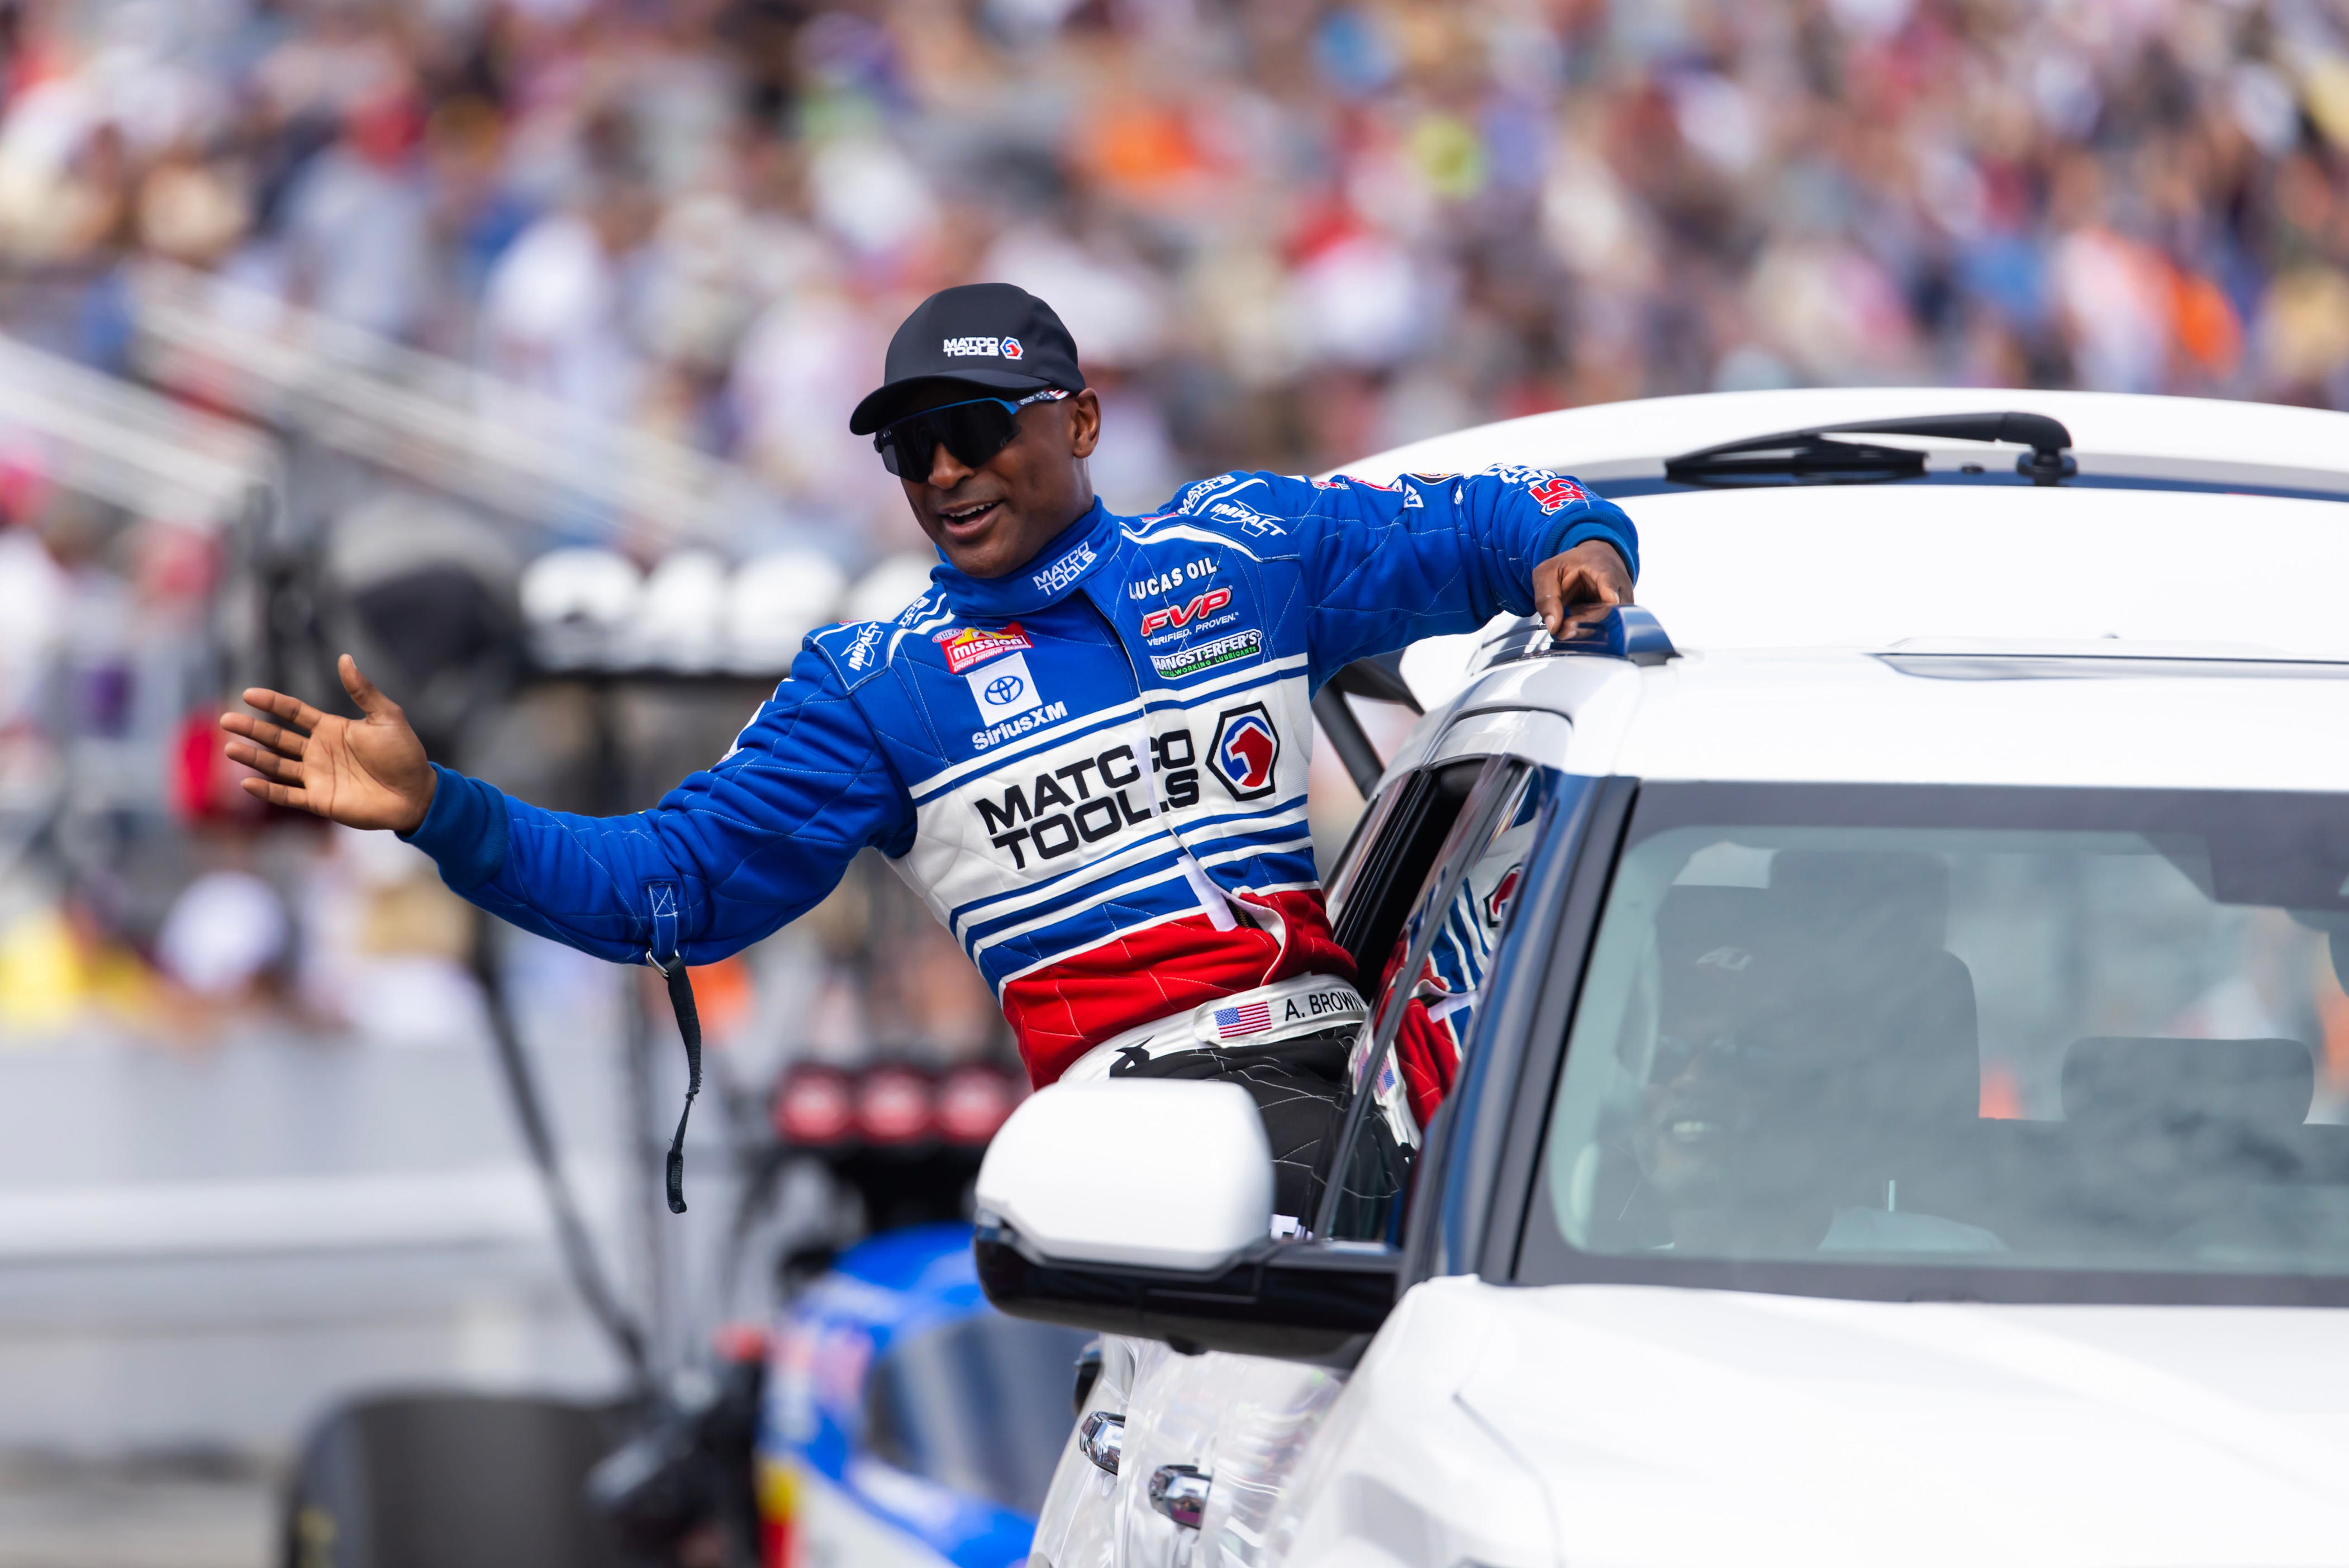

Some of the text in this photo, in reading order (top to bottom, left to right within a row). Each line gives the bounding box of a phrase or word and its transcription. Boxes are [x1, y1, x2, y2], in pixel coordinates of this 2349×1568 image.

[943, 337, 998, 349] MATCO
[943, 346, 999, 357] TOOLS
[1209, 503, 1287, 536] IMPACT
[1033, 541, 1089, 587] MATCO
[1038, 551, 1097, 596] TOOLS
[1129, 557, 1218, 600] LUCAS OIL
[1140, 588, 1231, 636] FVP
[1147, 613, 1236, 646] VERIFIED. PROVEN.
[848, 621, 880, 671] IMPACT
[1153, 632, 1258, 671] HANGSTERFER'S
[1160, 647, 1257, 677] METALWORKING LUBRICANTS
[972, 701, 1068, 750] SiriusXM
[974, 729, 1196, 835] MATCO
[992, 768, 1199, 869] TOOLS
[1285, 991, 1364, 1021] A. BROWN
